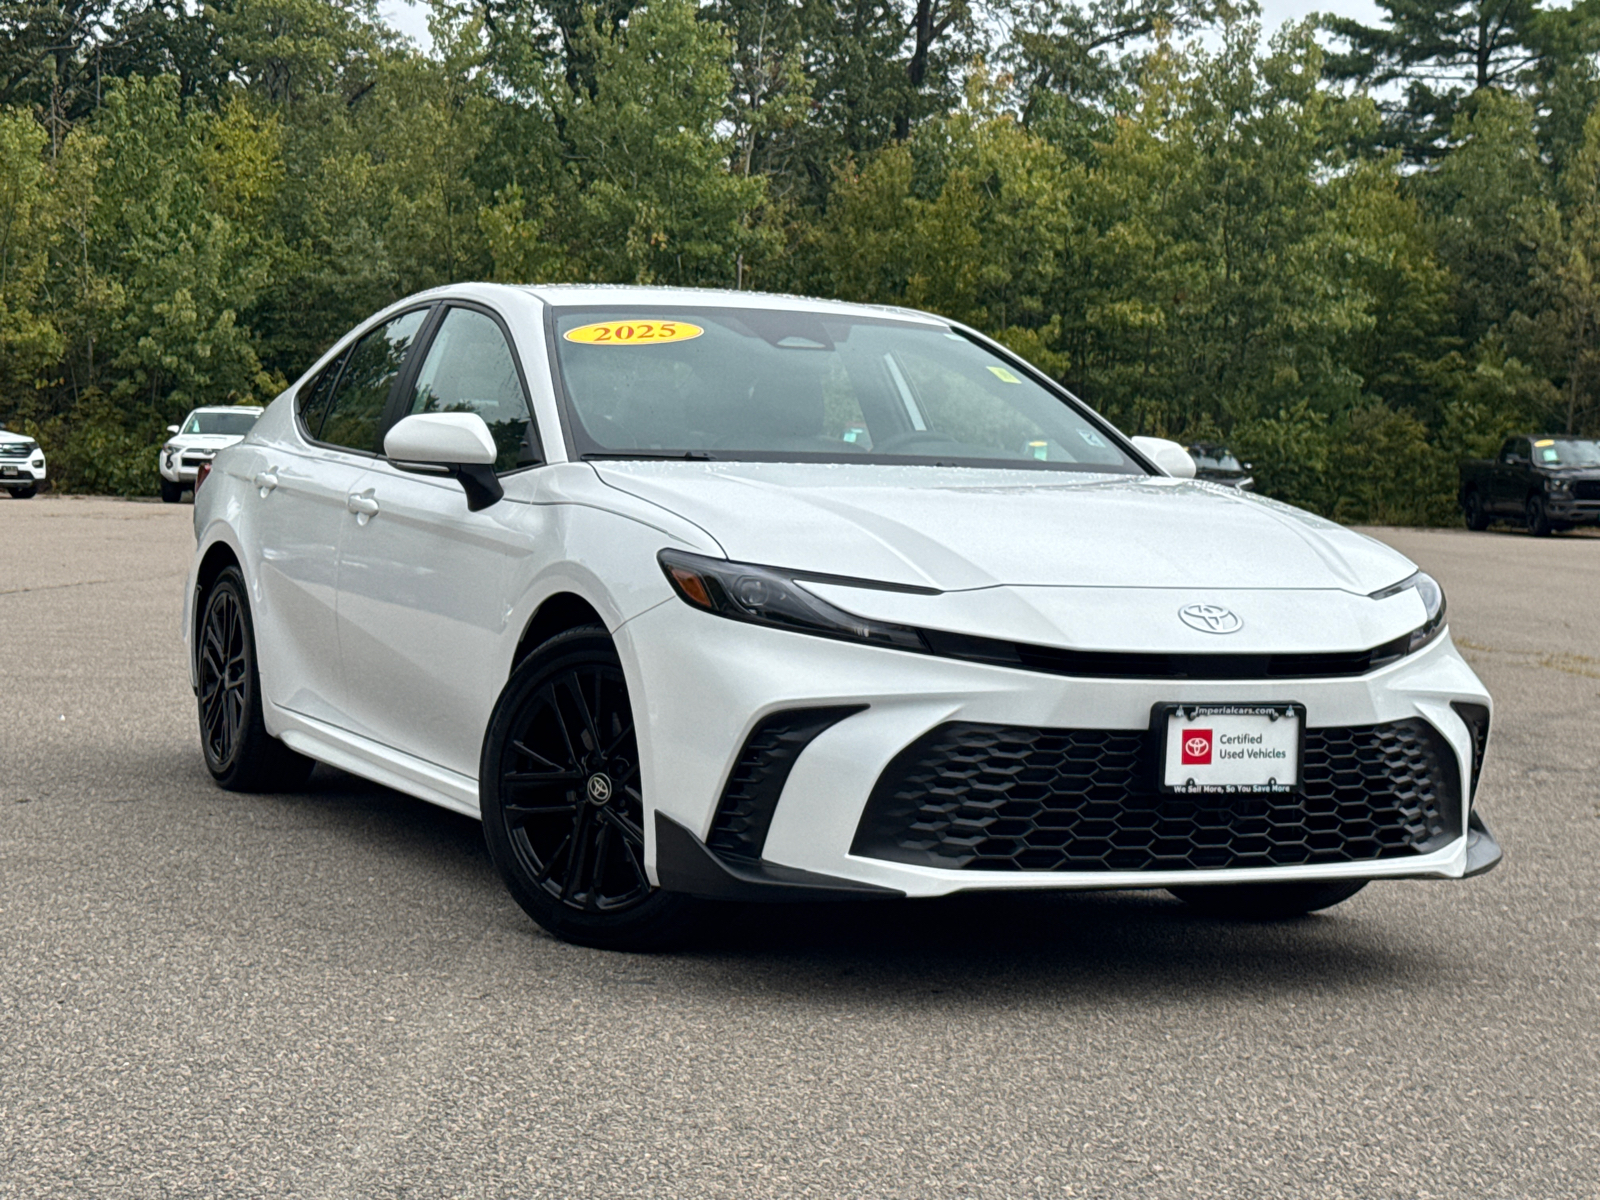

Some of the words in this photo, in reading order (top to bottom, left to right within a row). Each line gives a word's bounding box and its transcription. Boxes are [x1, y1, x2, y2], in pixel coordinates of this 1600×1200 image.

[593, 323, 676, 341] 2025
[1220, 733, 1262, 744] Certified
[1219, 749, 1244, 759] Used
[1246, 748, 1286, 759] Vehicles
[1174, 785, 1187, 793] We
[1188, 785, 1201, 793] Sell
[1203, 785, 1224, 794] More,
[1226, 785, 1235, 793] So
[1237, 785, 1251, 793] You
[1253, 785, 1270, 793] Save
[1272, 785, 1290, 793] More
